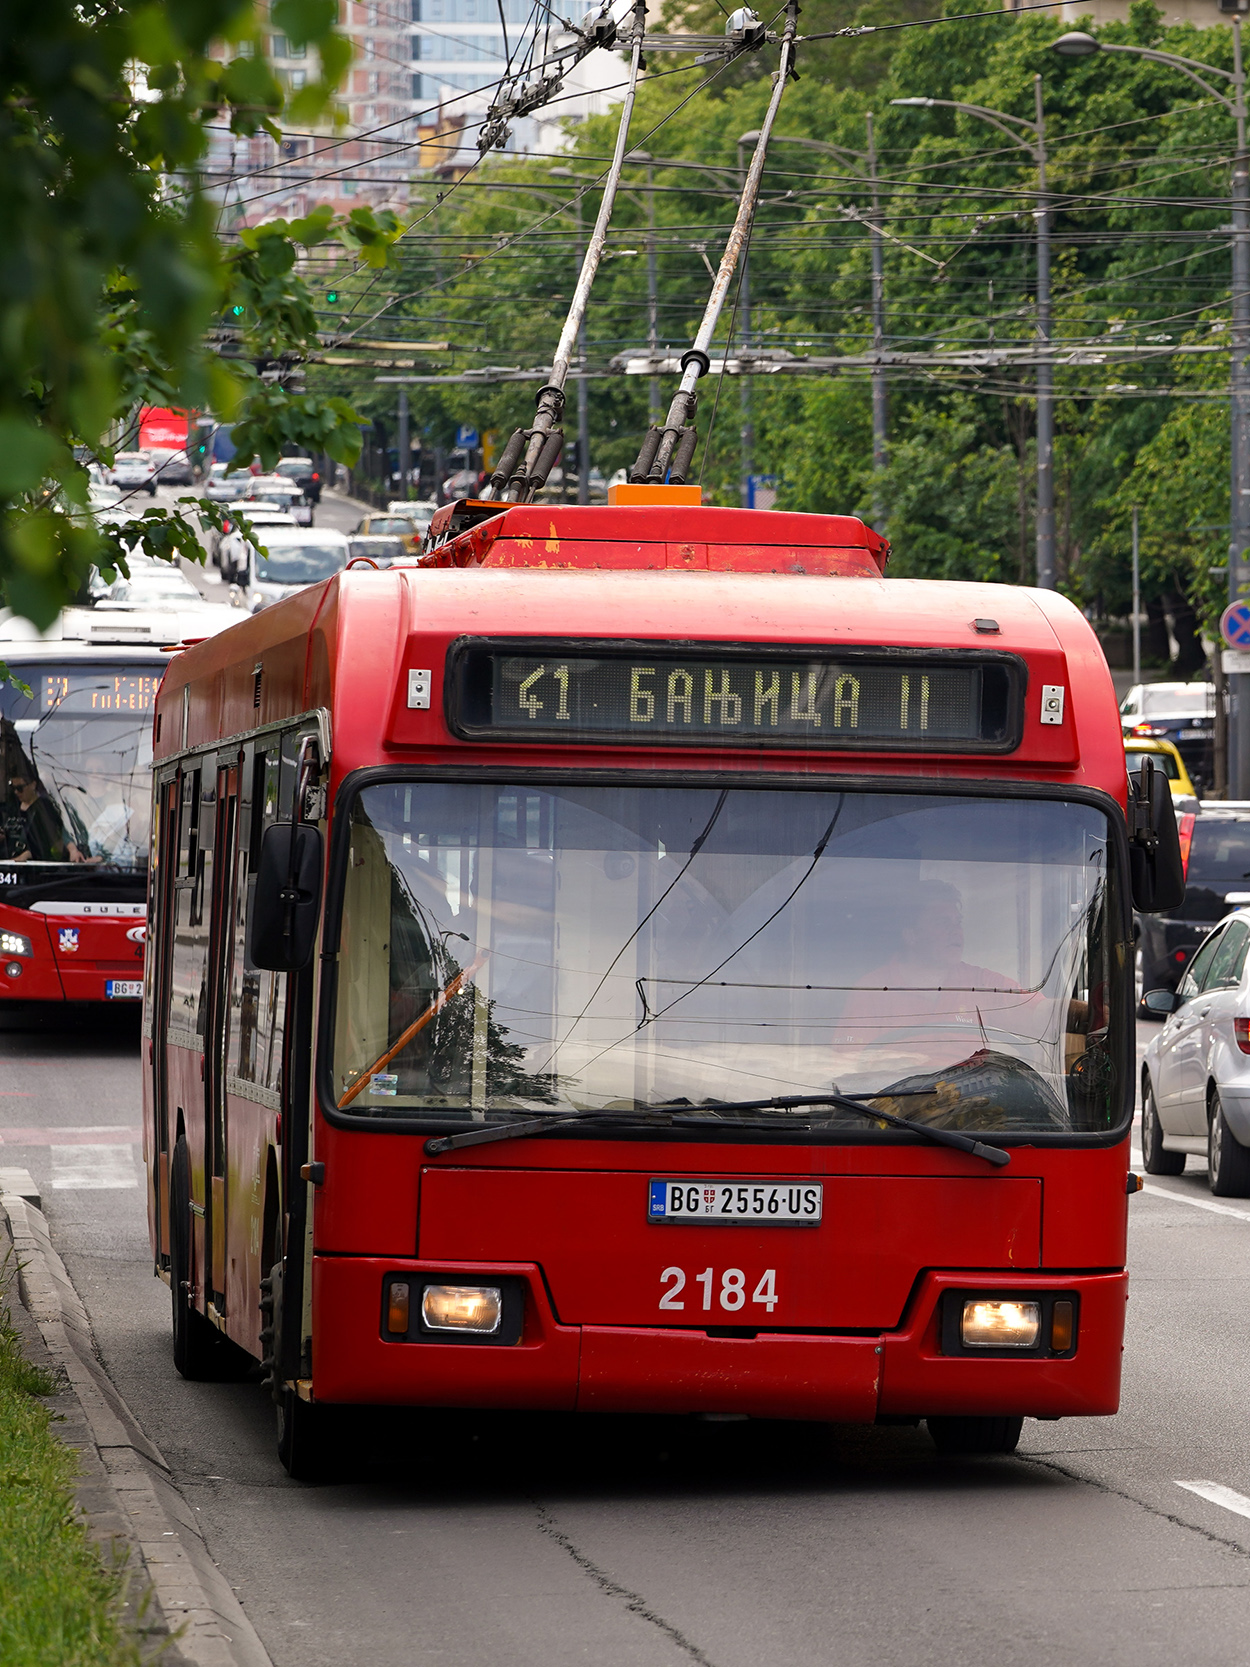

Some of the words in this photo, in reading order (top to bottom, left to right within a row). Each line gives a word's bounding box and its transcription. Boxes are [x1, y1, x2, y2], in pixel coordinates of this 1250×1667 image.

[519, 665, 571, 720] 41
[630, 667, 860, 728] БАЊИЦА
[114, 982, 128, 994] BG
[670, 1186, 700, 1212] BG
[658, 1266, 779, 1312] 2184
